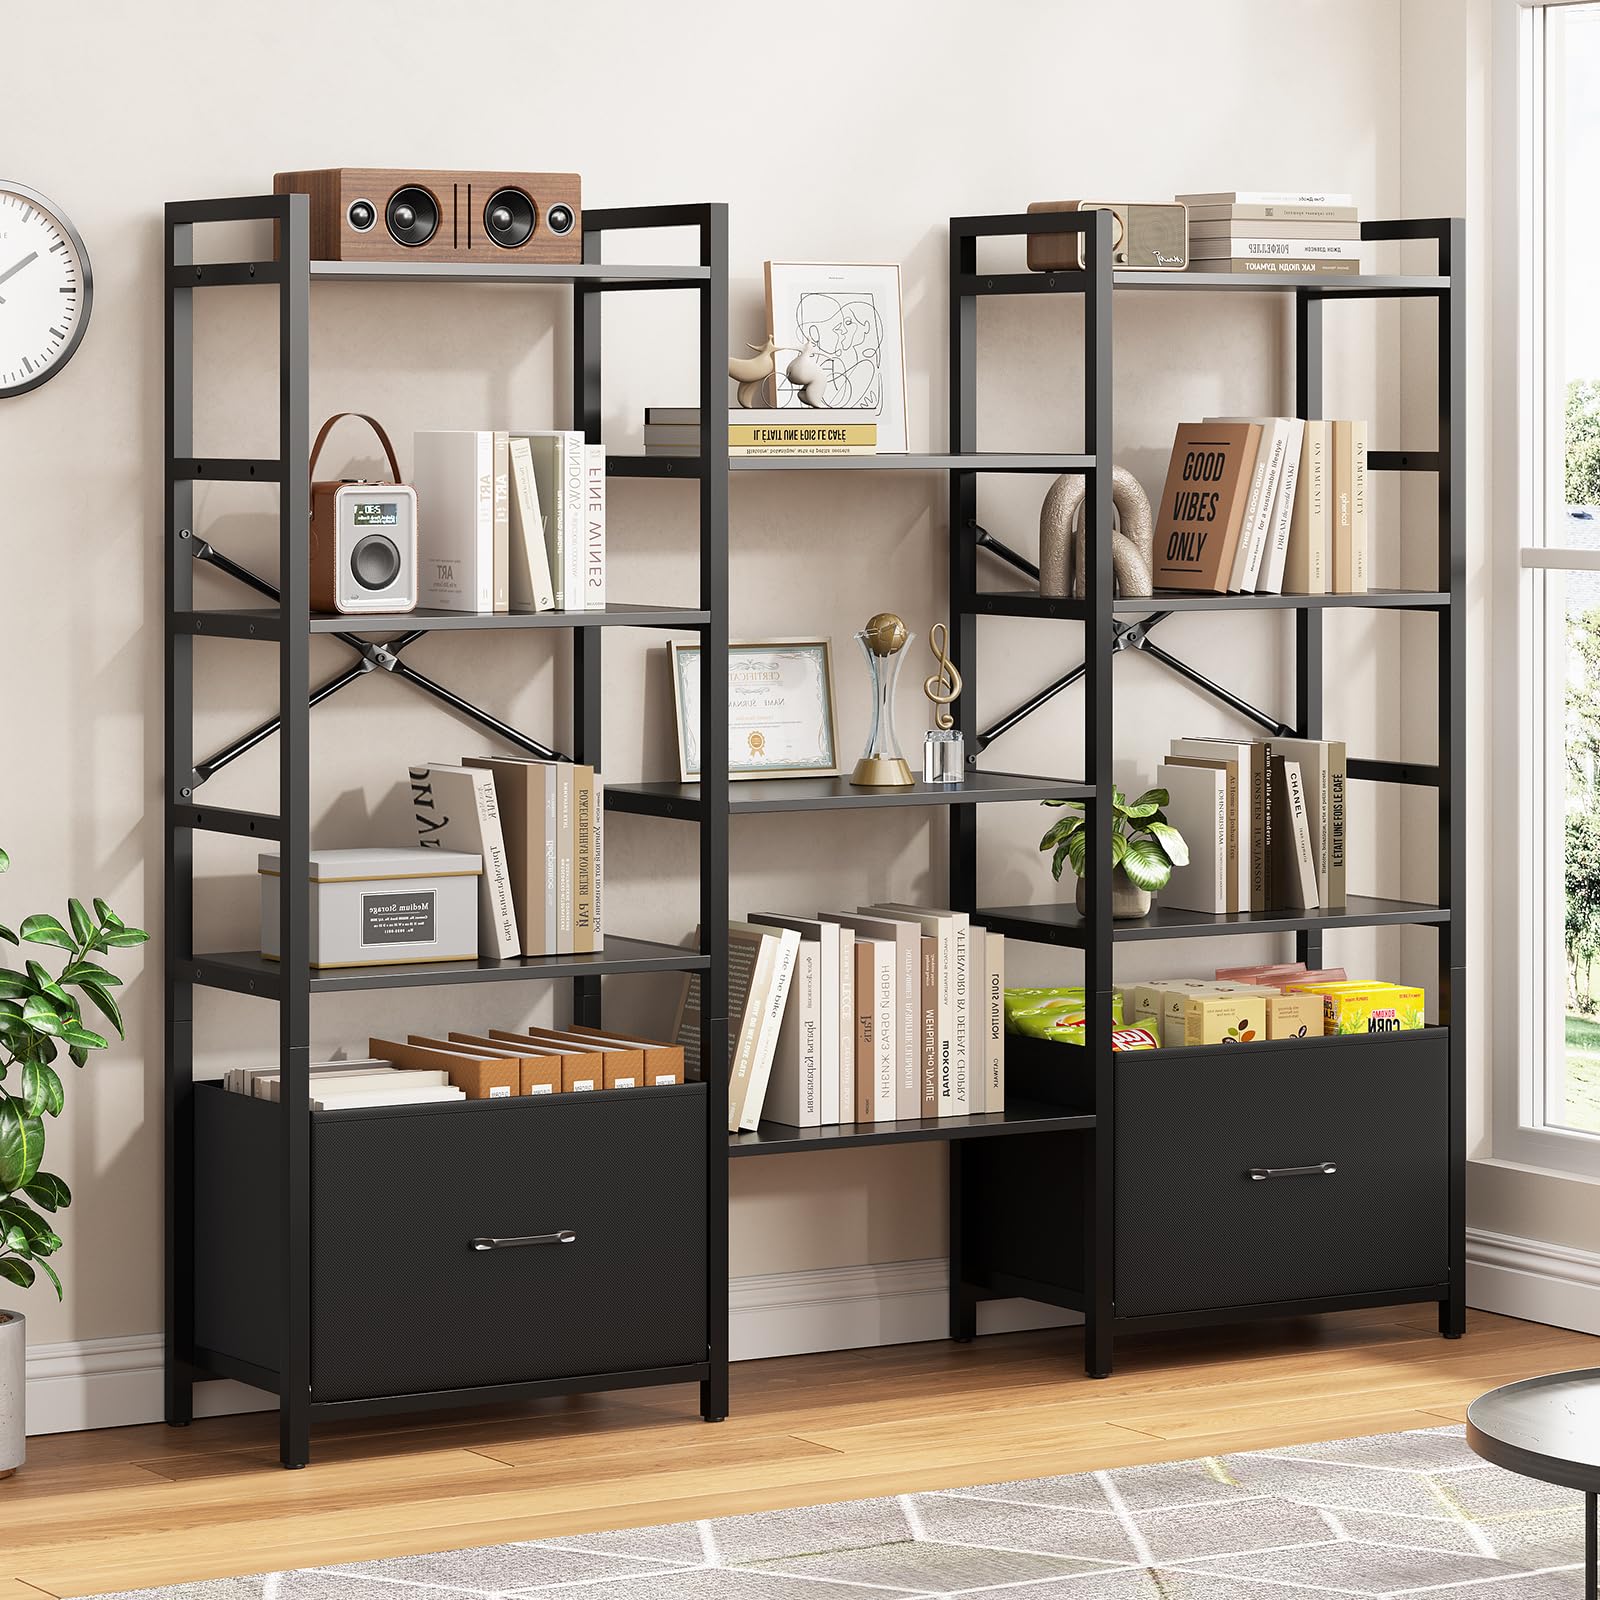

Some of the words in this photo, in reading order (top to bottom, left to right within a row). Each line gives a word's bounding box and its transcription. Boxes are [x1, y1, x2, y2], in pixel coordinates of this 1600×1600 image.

[1271, 439, 1283, 471] lifestyle
[1315, 442, 1321, 456] ON
[1356, 442, 1362, 456] ON
[1182, 452, 1226, 482] GOOD
[1262, 471, 1277, 511] sustainable
[1173, 492, 1219, 522] VIBES
[1261, 511, 1267, 520] a
[1257, 519, 1266, 531] for
[1277, 520, 1287, 551] DREAM
[1166, 531, 1208, 562] ONLY
[1331, 774, 1343, 793] CAFÉ
[1291, 772, 1303, 819] CHANEL
[1333, 794, 1343, 803] LE
[1333, 804, 1343, 820] FOIS
[1333, 822, 1343, 837] UNE
[1331, 838, 1343, 859] ÉTAIT
[1333, 859, 1343, 867] IL
[782, 945, 792, 972] ride
[777, 972, 787, 993] the
[771, 992, 782, 1019] bike
